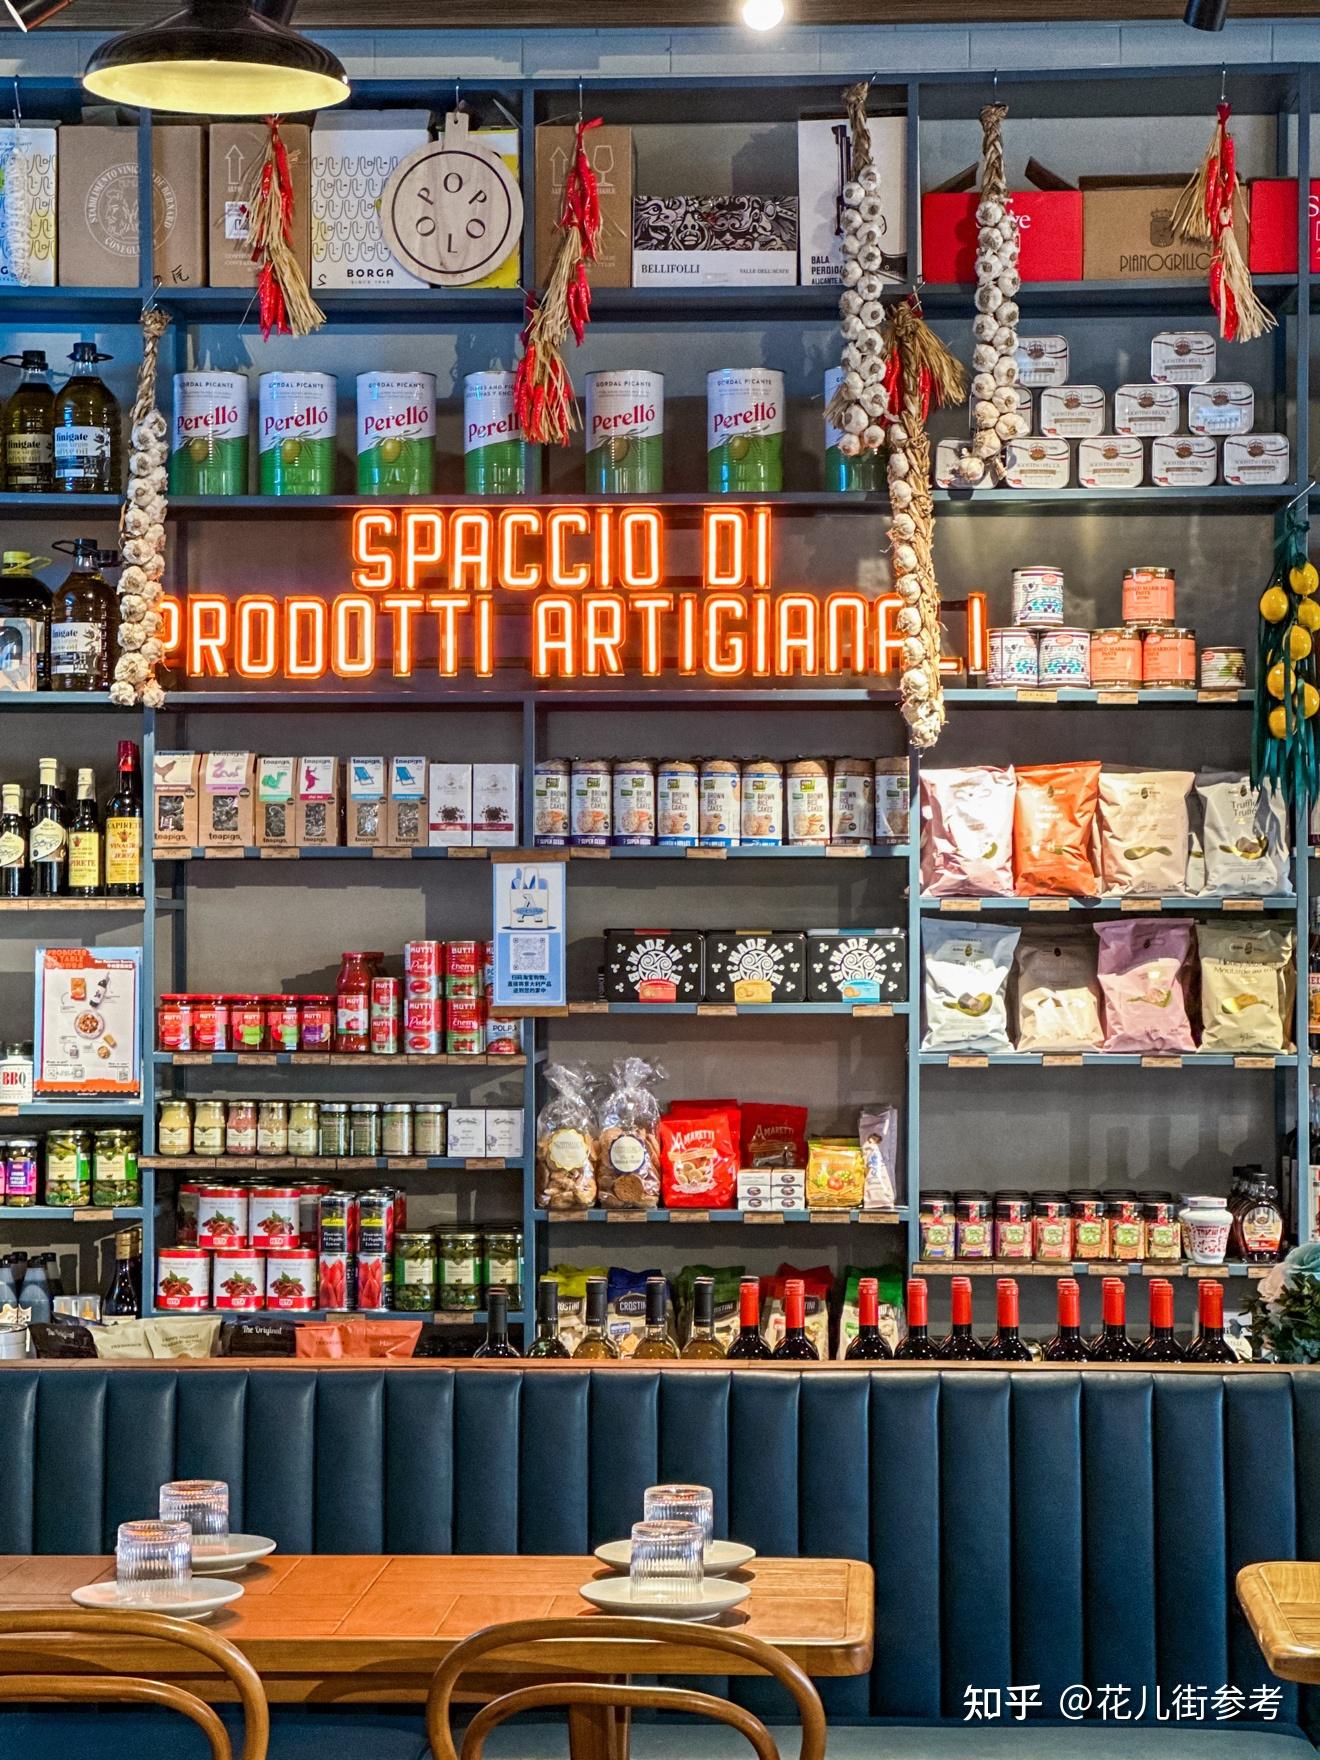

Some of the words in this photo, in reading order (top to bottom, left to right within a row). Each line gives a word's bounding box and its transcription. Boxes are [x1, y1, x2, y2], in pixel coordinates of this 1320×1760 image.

[347, 268, 394, 278] BORGA
[641, 264, 701, 274] BELLIFOLLI
[811, 255, 830, 264] BALA
[178, 405, 238, 434] Perelló
[265, 405, 329, 435] Perelló
[365, 406, 429, 435] Perelló
[468, 412, 520, 442] Perell
[592, 404, 656, 434] Perelló
[713, 402, 777, 432] Perelló
[351, 507, 664, 591] SPACCIO
[703, 506, 772, 590] DI
[627, 938, 665, 965] MADE
[666, 944, 683, 962] IN
[727, 938, 767, 963] MADE
[766, 943, 785, 962] IN
[829, 938, 868, 963] MADE
[868, 943, 886, 961] IN
[2, 1071, 27, 1085] BBQ
[619, 1300, 646, 1311] CROSTIN
